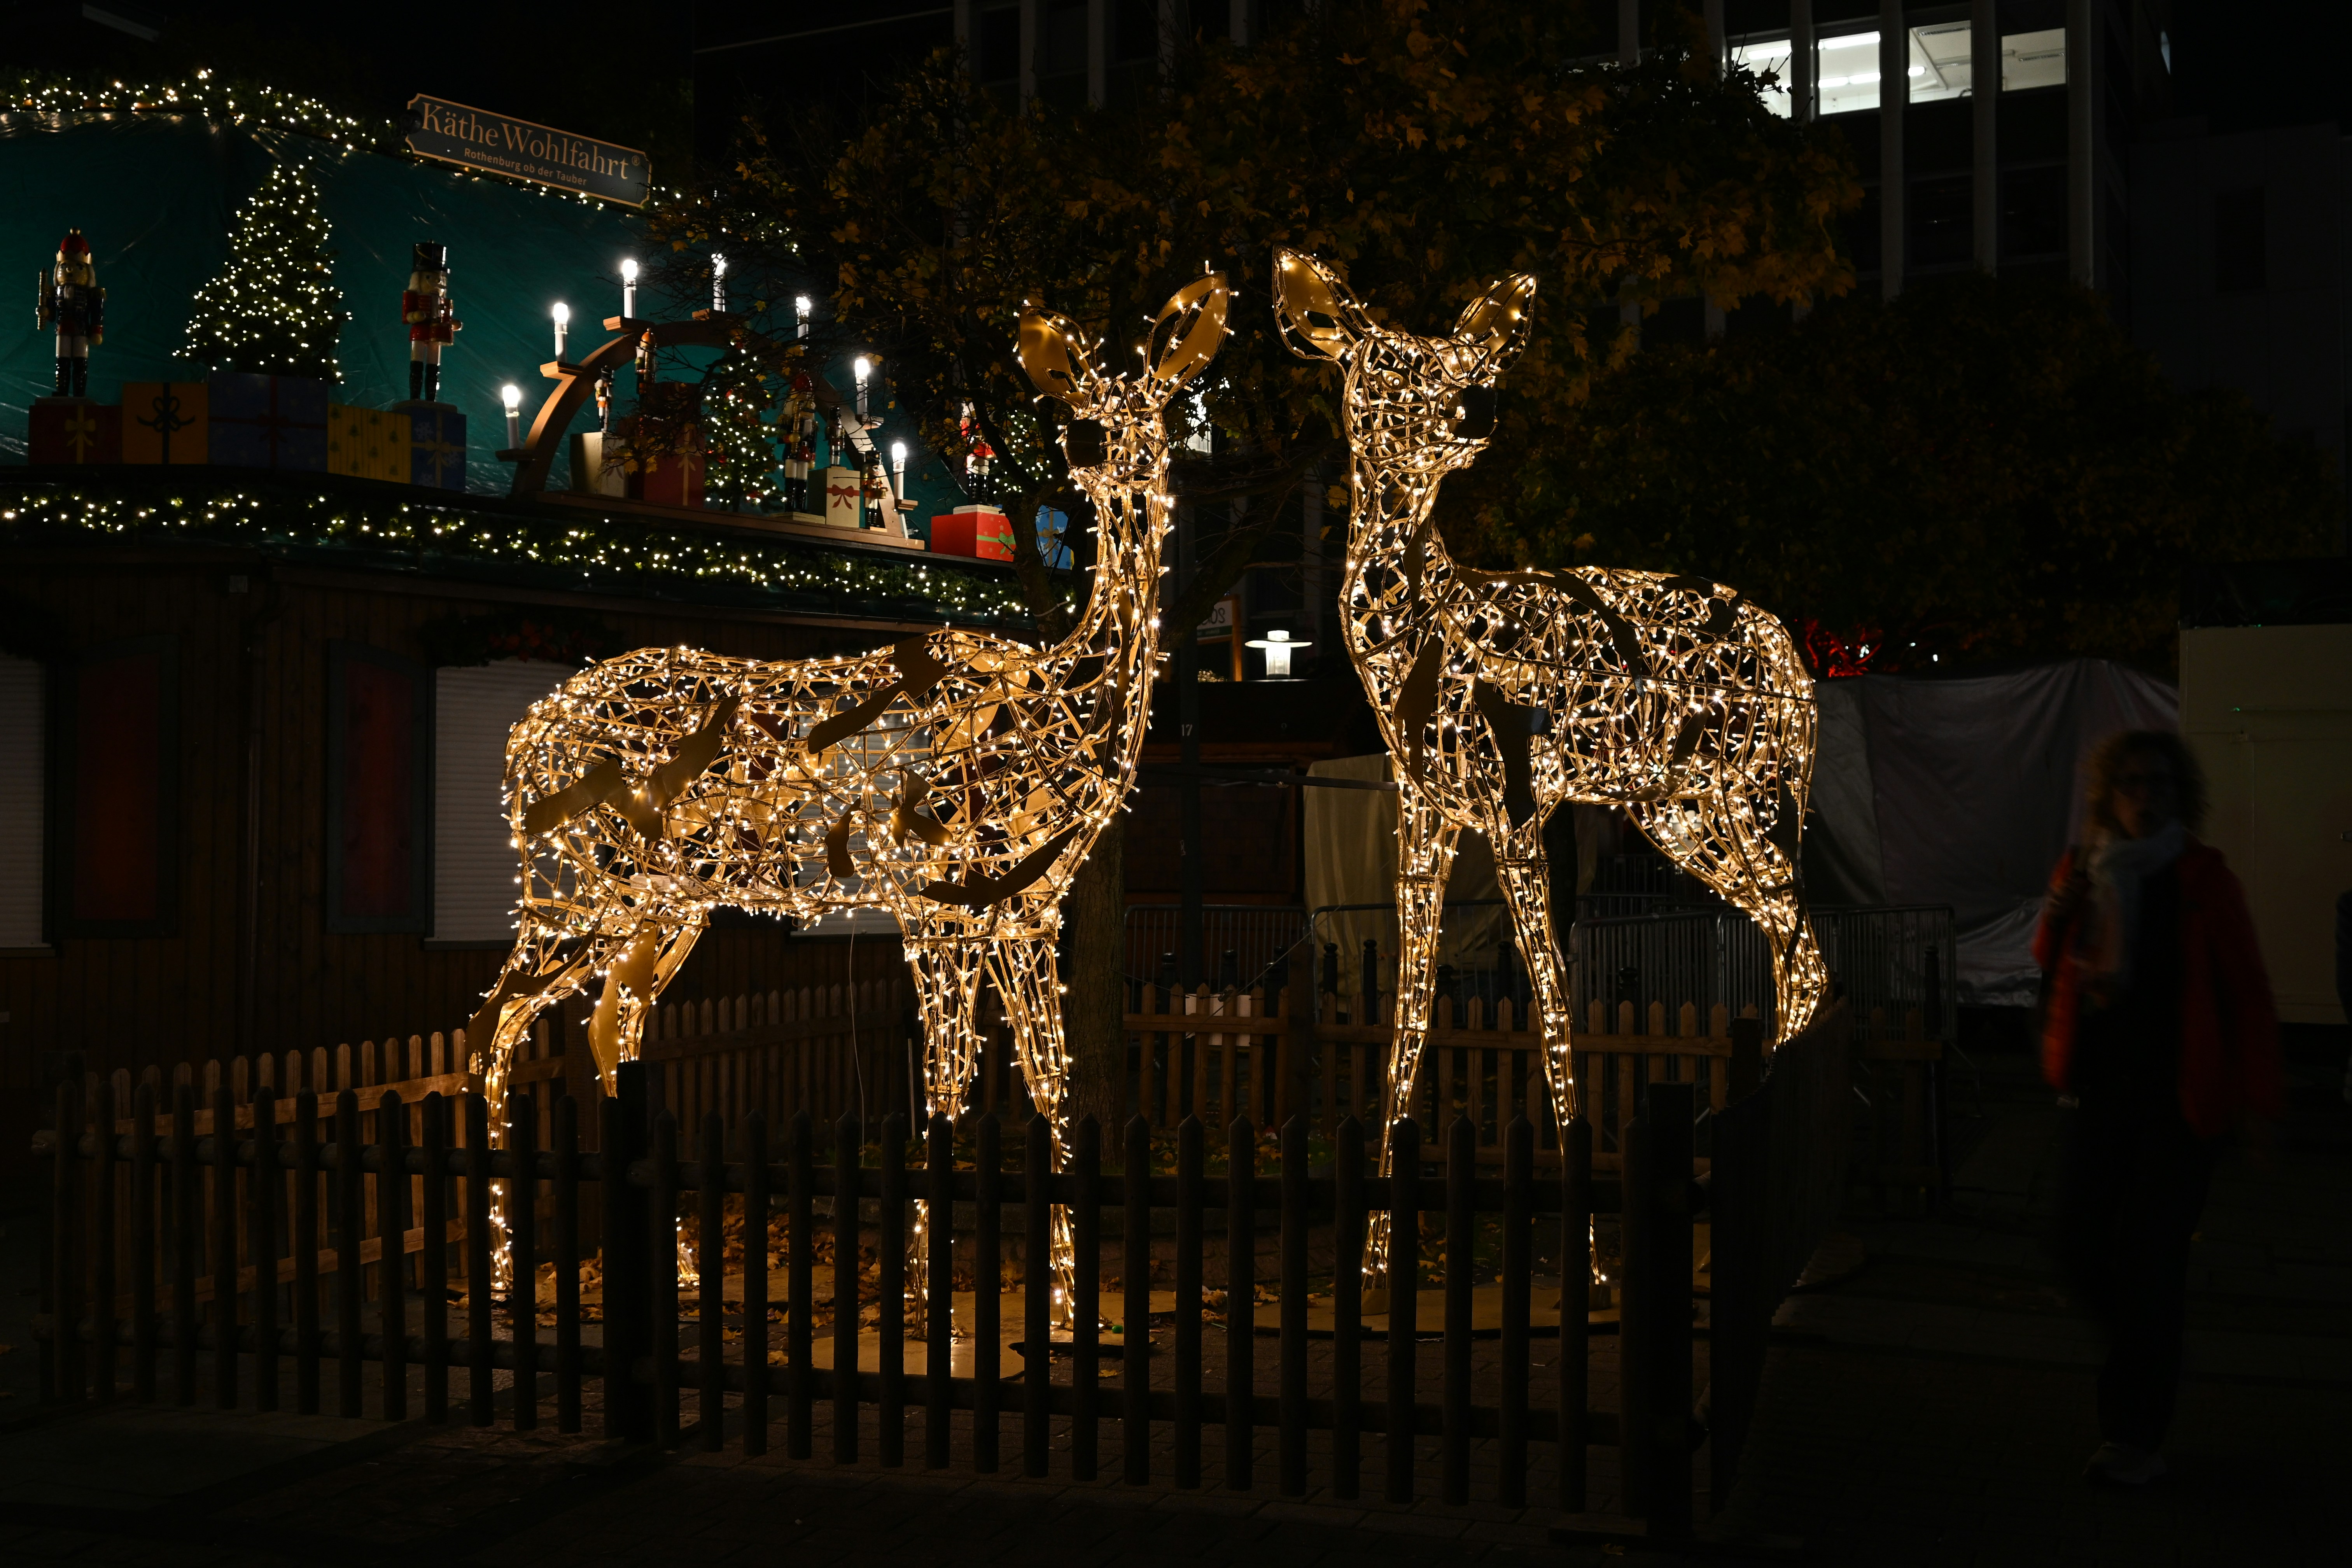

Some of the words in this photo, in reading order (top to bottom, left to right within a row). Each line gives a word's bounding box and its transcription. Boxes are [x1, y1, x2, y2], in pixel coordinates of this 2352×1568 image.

[422, 102, 499, 147] Käthe
[464, 147, 521, 172] Rothenburg
[523, 163, 535, 173] ob
[538, 166, 553, 177] der
[556, 170, 587, 186] Tauber
[1181, 724, 1193, 737] 17
